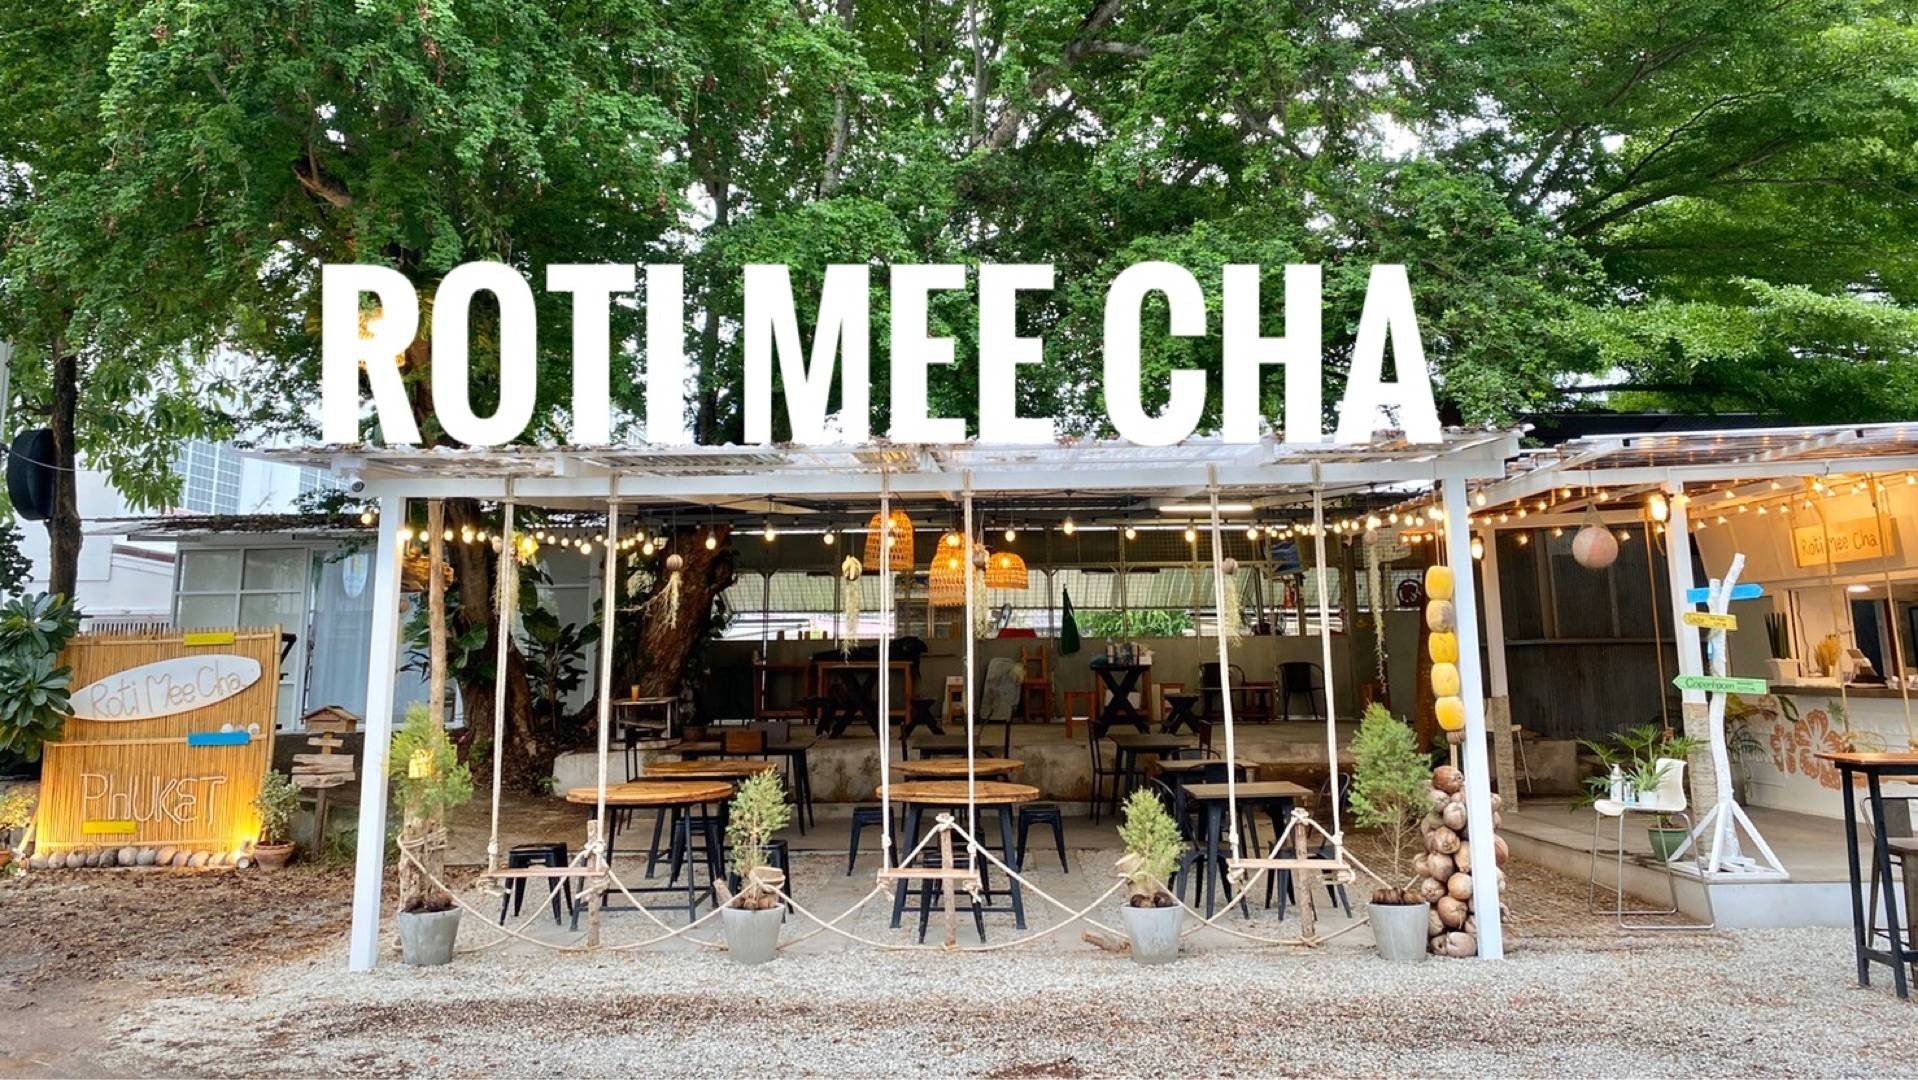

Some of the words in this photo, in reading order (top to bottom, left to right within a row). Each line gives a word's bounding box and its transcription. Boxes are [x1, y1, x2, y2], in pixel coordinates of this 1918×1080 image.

[1852, 528, 1878, 550] Cha
[90, 679, 140, 719] Roti
[146, 672, 196, 714] Mee
[196, 660, 247, 698] Cha
